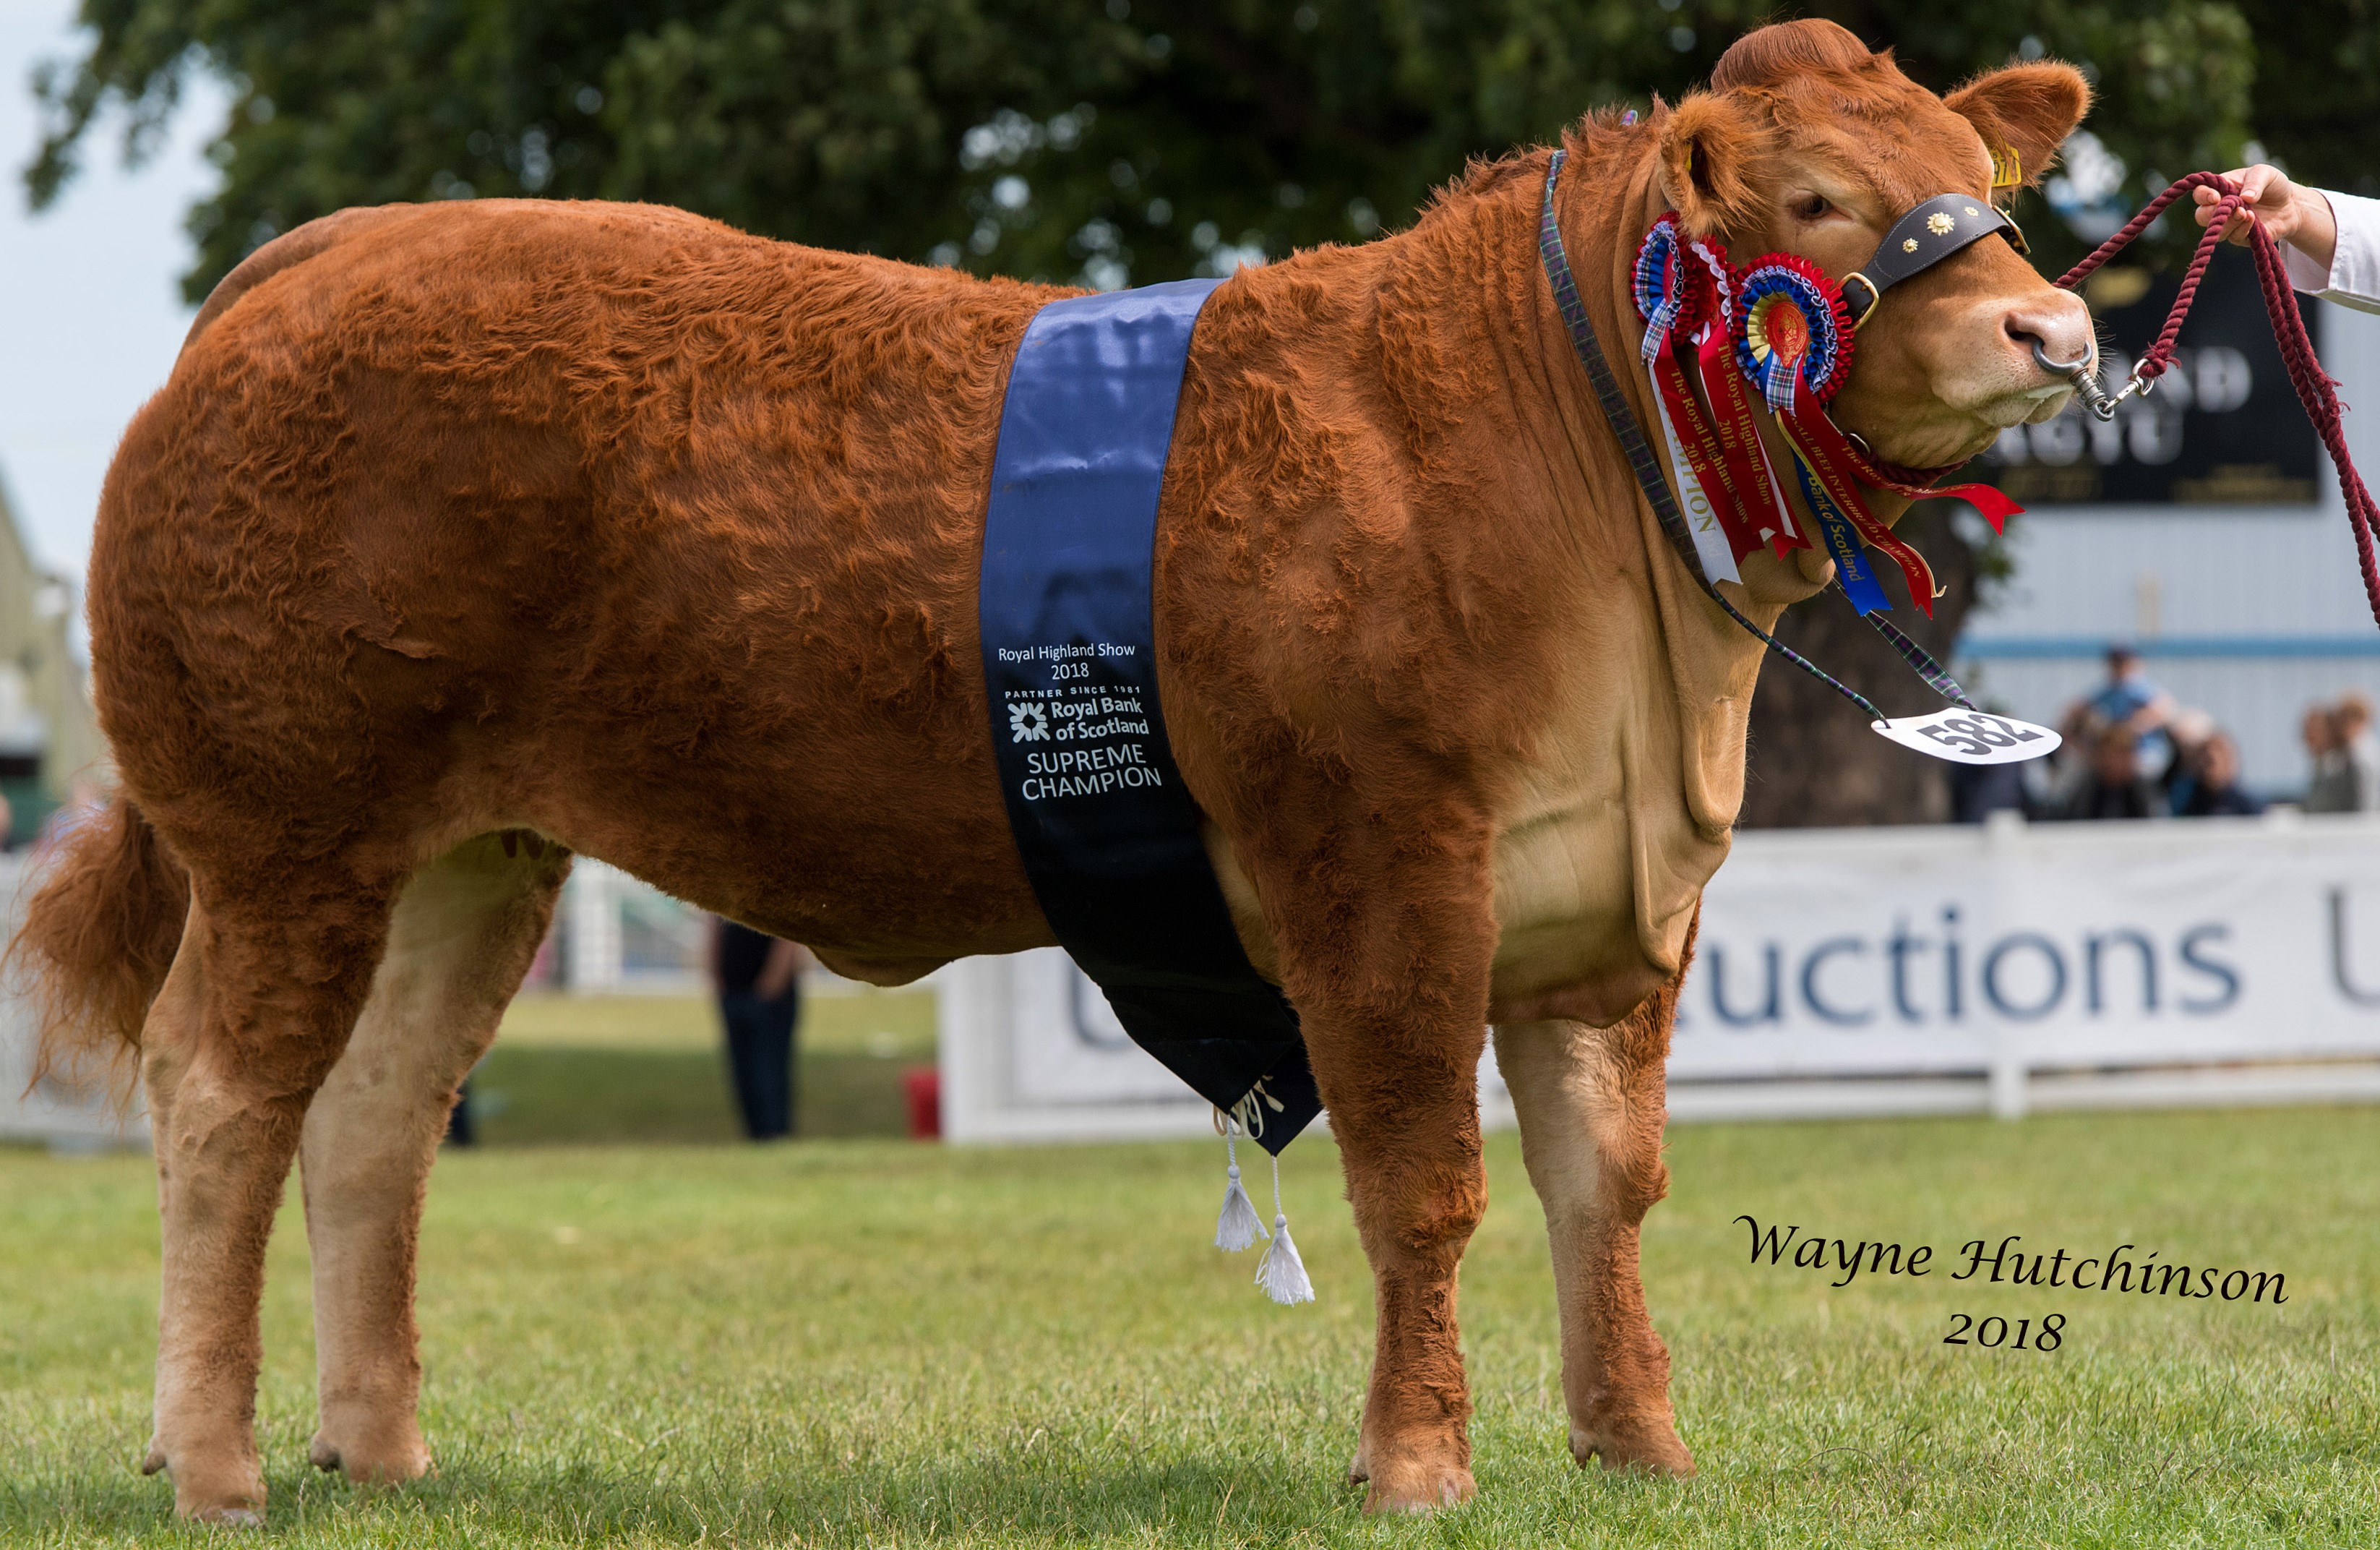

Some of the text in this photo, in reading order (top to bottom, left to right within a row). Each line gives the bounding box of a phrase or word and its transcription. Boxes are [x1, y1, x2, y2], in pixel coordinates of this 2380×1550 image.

[1671, 368, 1687, 395] The
[1683, 397, 1709, 435] Royal
[1702, 435, 1737, 493] Highland
[1718, 341, 1772, 506] The Royal Highland Show
[1718, 419, 1737, 449] 2018
[1683, 442, 1706, 474] 2018
[1810, 446, 1834, 473] BEEF
[1842, 441, 1861, 464] The
[1822, 512, 1842, 523] of
[1830, 524, 1865, 582] Scotland
[998, 643, 1135, 663] Royal Highland Show
[1051, 662, 1089, 680] 2018
[1005, 685, 1140, 699] PARTNER SINCE 1981
[1051, 697, 1143, 721] Royal Bank
[1056, 717, 1149, 741] of Scotland
[1915, 714, 2045, 755] 582
[1027, 744, 1147, 774] SUPREME
[1022, 766, 1162, 800] CHAMPION
[1675, 905, 2243, 1031] uctions
